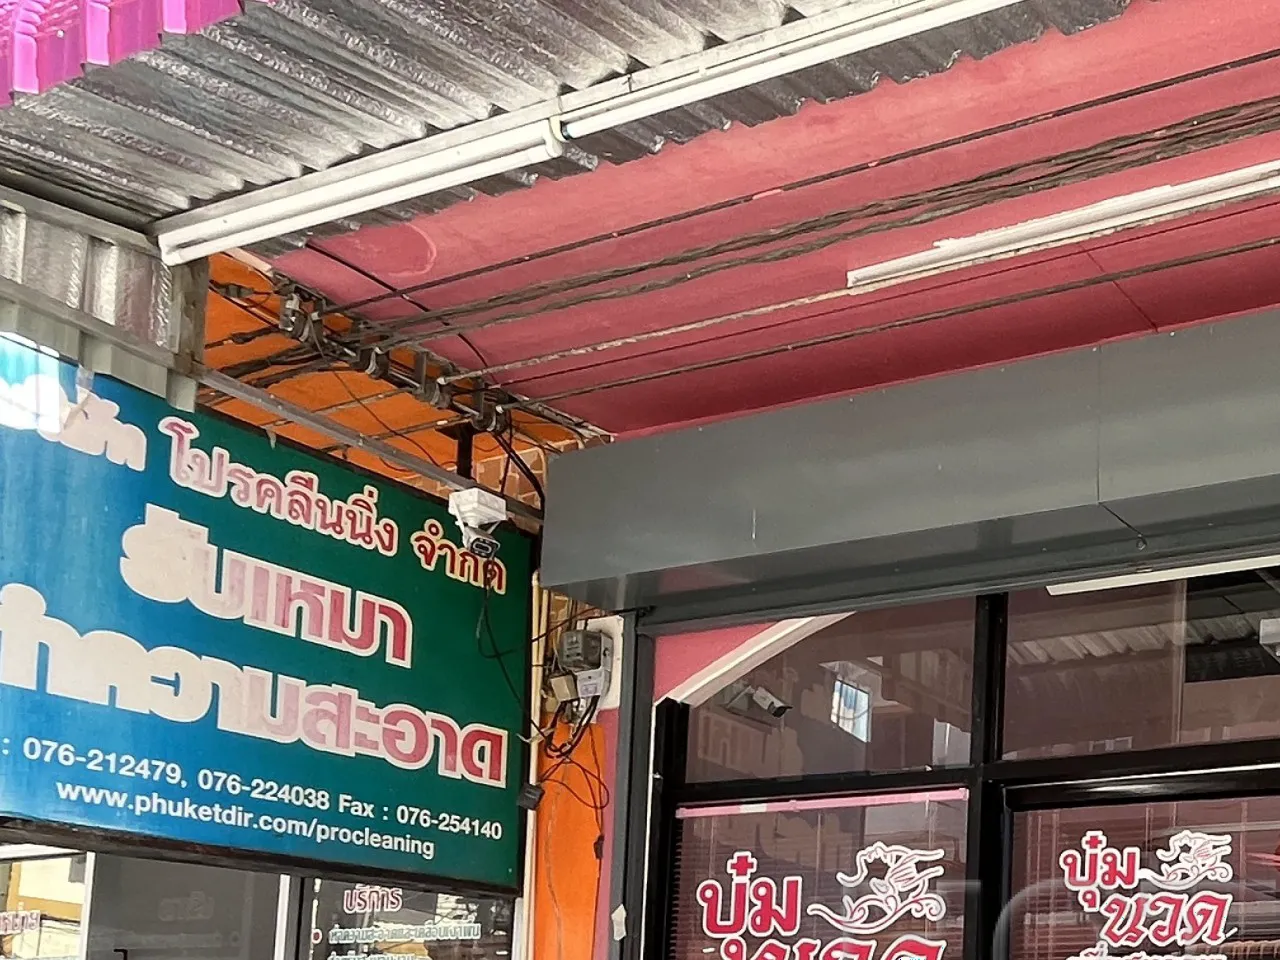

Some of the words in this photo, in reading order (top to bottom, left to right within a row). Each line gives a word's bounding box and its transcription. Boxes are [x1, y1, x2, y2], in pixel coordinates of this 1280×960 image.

[158, 417, 398, 555] โปรคลีนนิ่ง
[0, 583, 506, 788] ำความสะอาด
[23, 737, 187, 788] 076-212479,
[198, 769, 330, 810] 076-224038
[339, 794, 374, 818] Fax
[397, 805, 502, 840] 076-254140
[56, 782, 435, 859] www.phuketdir.com/procleaning
[343, 884, 402, 914] บริการ
[1061, 831, 1139, 910] บุ๋ม
[1099, 890, 1232, 947] นวด
